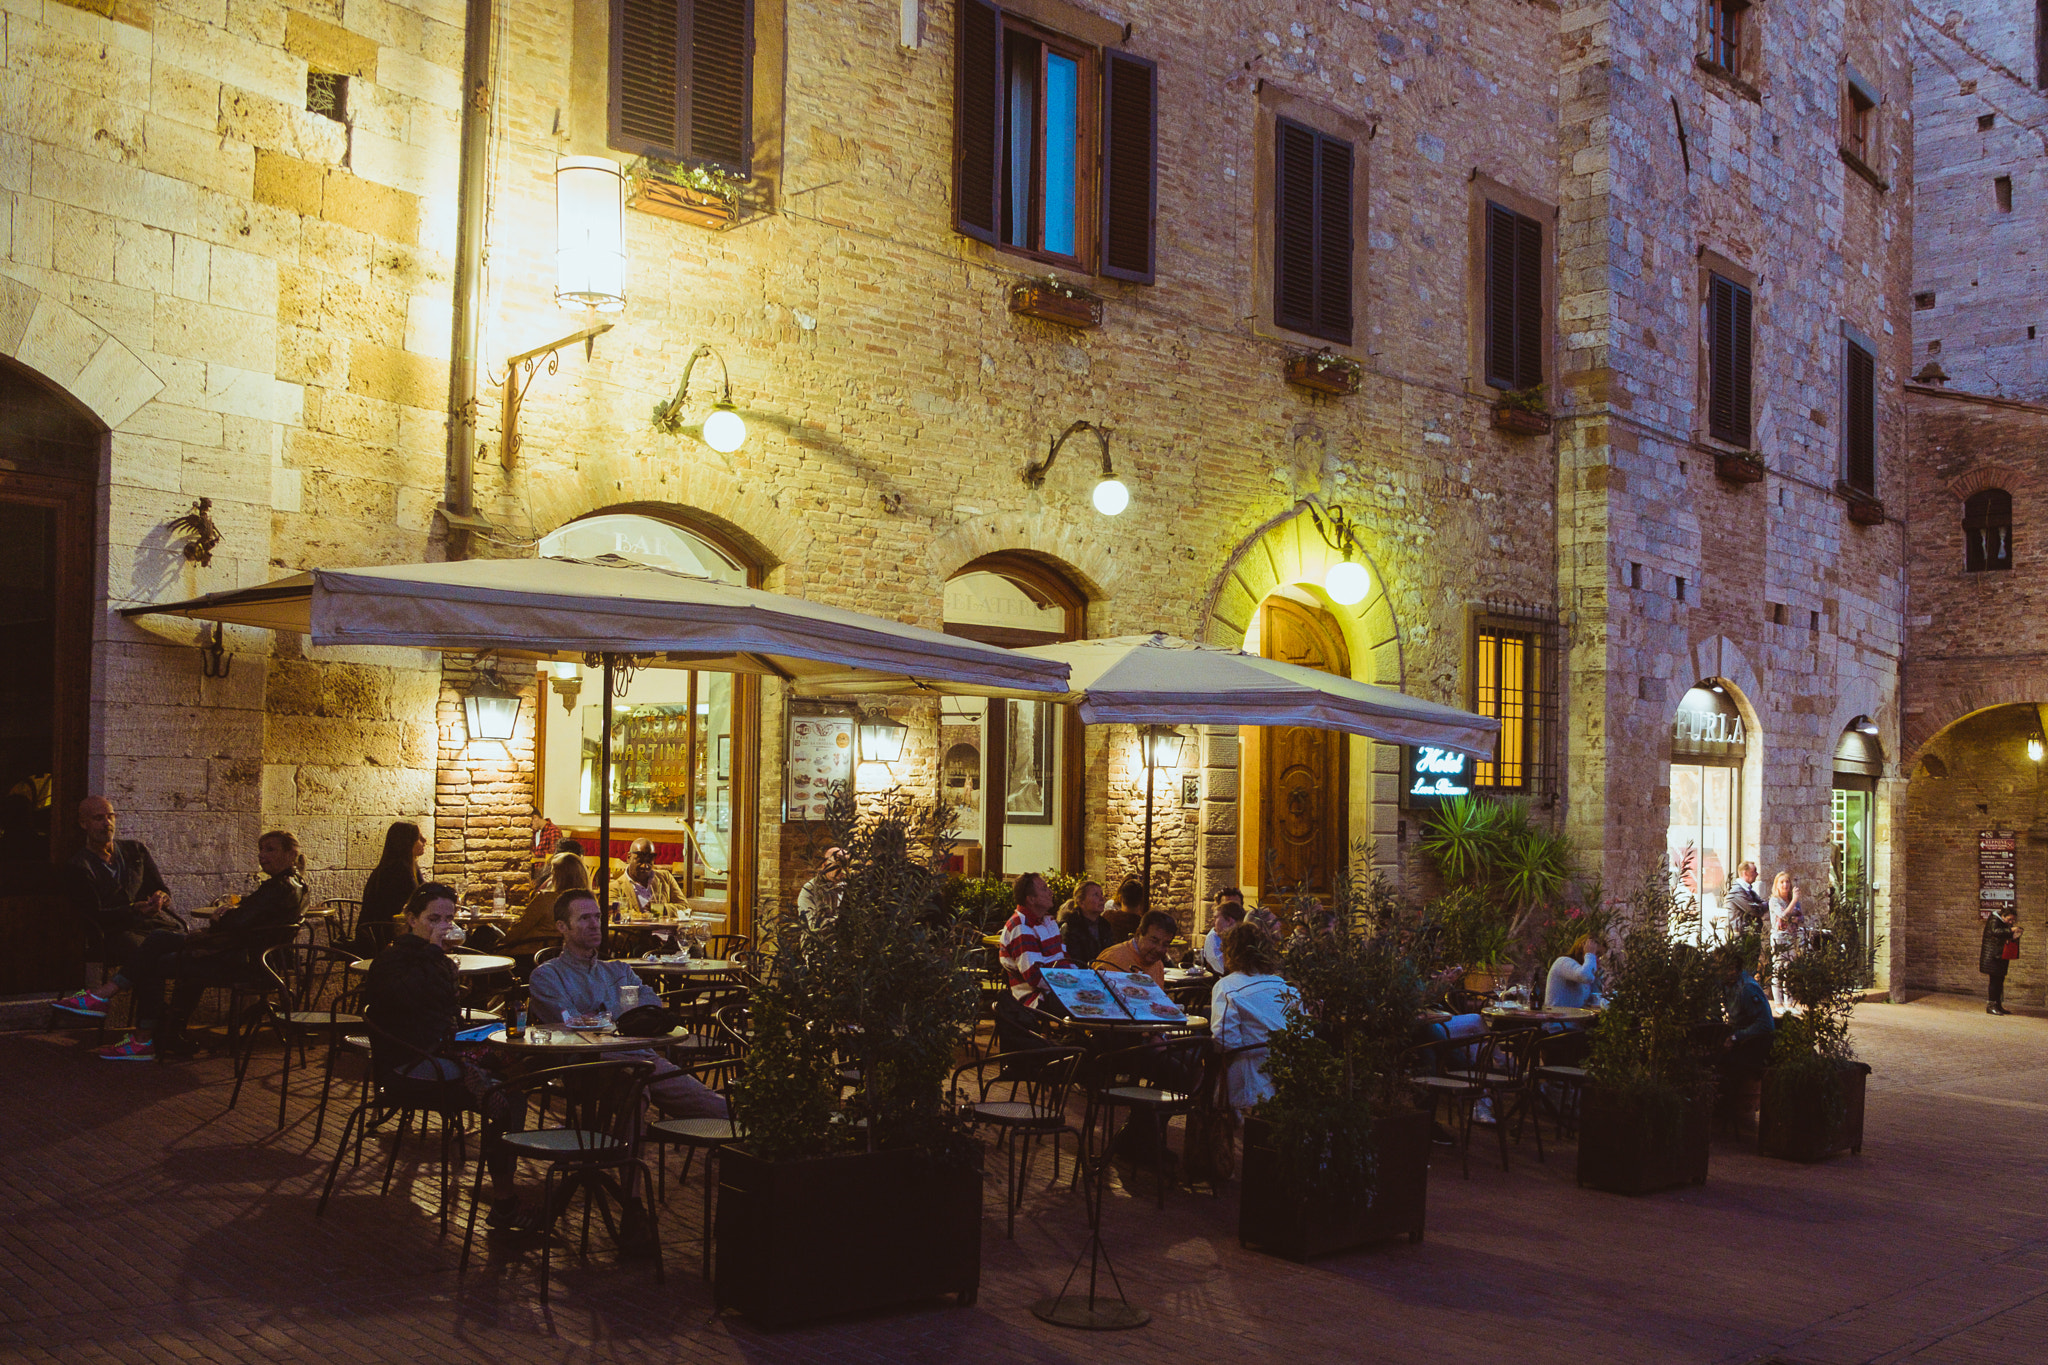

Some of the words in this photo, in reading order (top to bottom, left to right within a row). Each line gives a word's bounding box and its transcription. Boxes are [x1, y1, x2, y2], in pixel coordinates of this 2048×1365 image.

[614, 532, 672, 556] BAR
[1674, 708, 1745, 745] FURLA
[1416, 746, 1465, 773] Hotel
